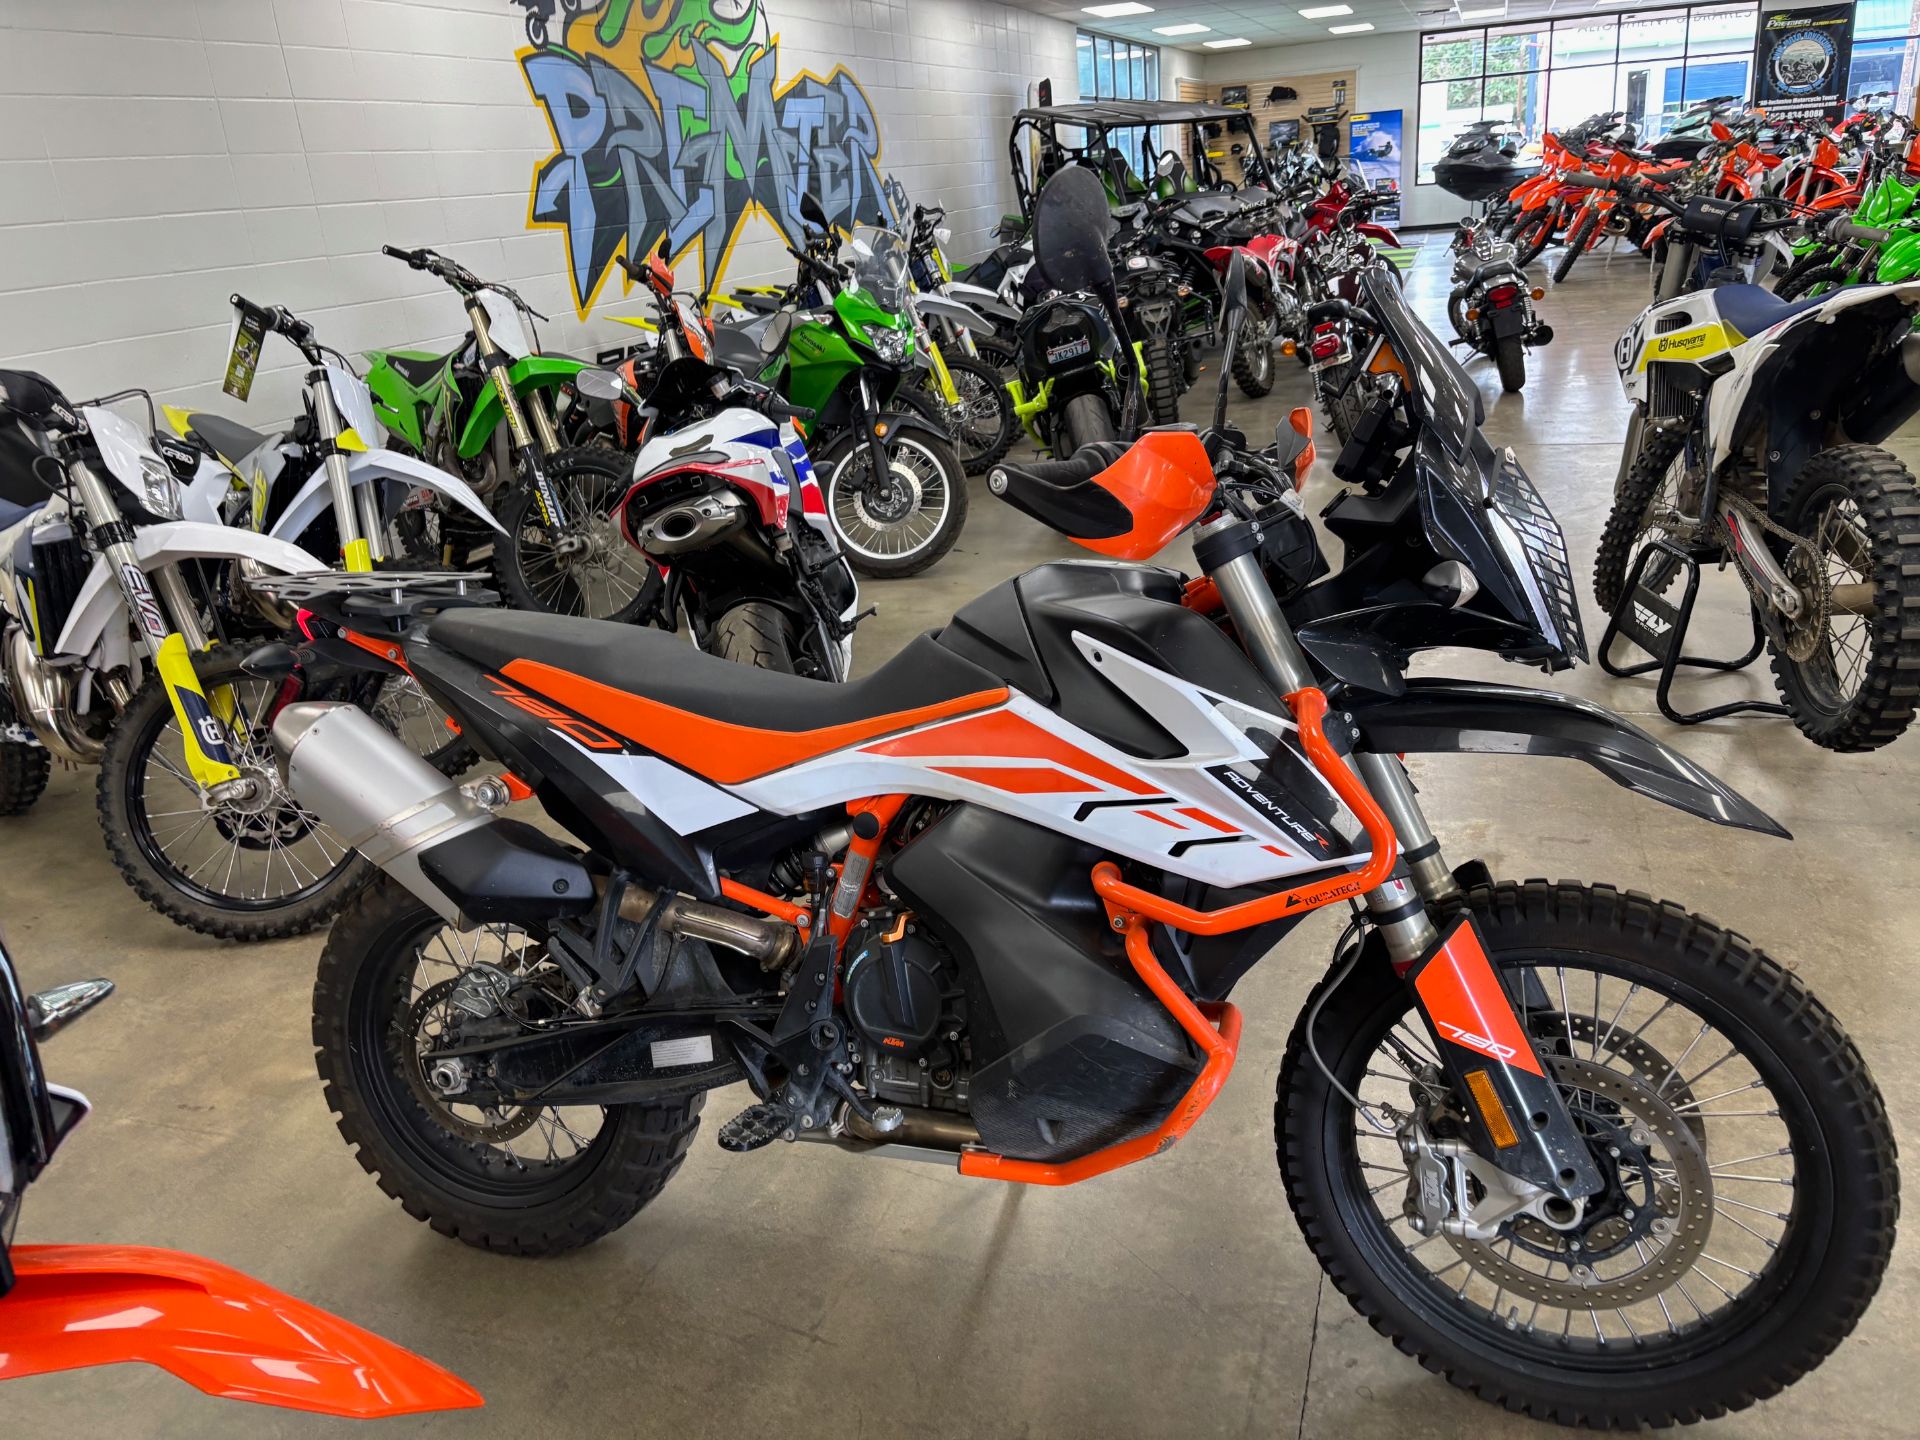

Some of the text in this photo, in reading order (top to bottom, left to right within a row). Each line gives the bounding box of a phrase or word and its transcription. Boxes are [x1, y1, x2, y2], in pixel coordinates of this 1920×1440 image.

[1668, 333, 1706, 350] Husqvarna
[535, 471, 561, 528] DUNLOP
[1633, 600, 1672, 634] FLY
[483, 674, 623, 749] 790
[1224, 771, 1317, 842] ADVENTURE
[1301, 881, 1362, 906] TOURATECH
[883, 1036, 905, 1048] KTM
[1438, 1020, 1517, 1059] 790
